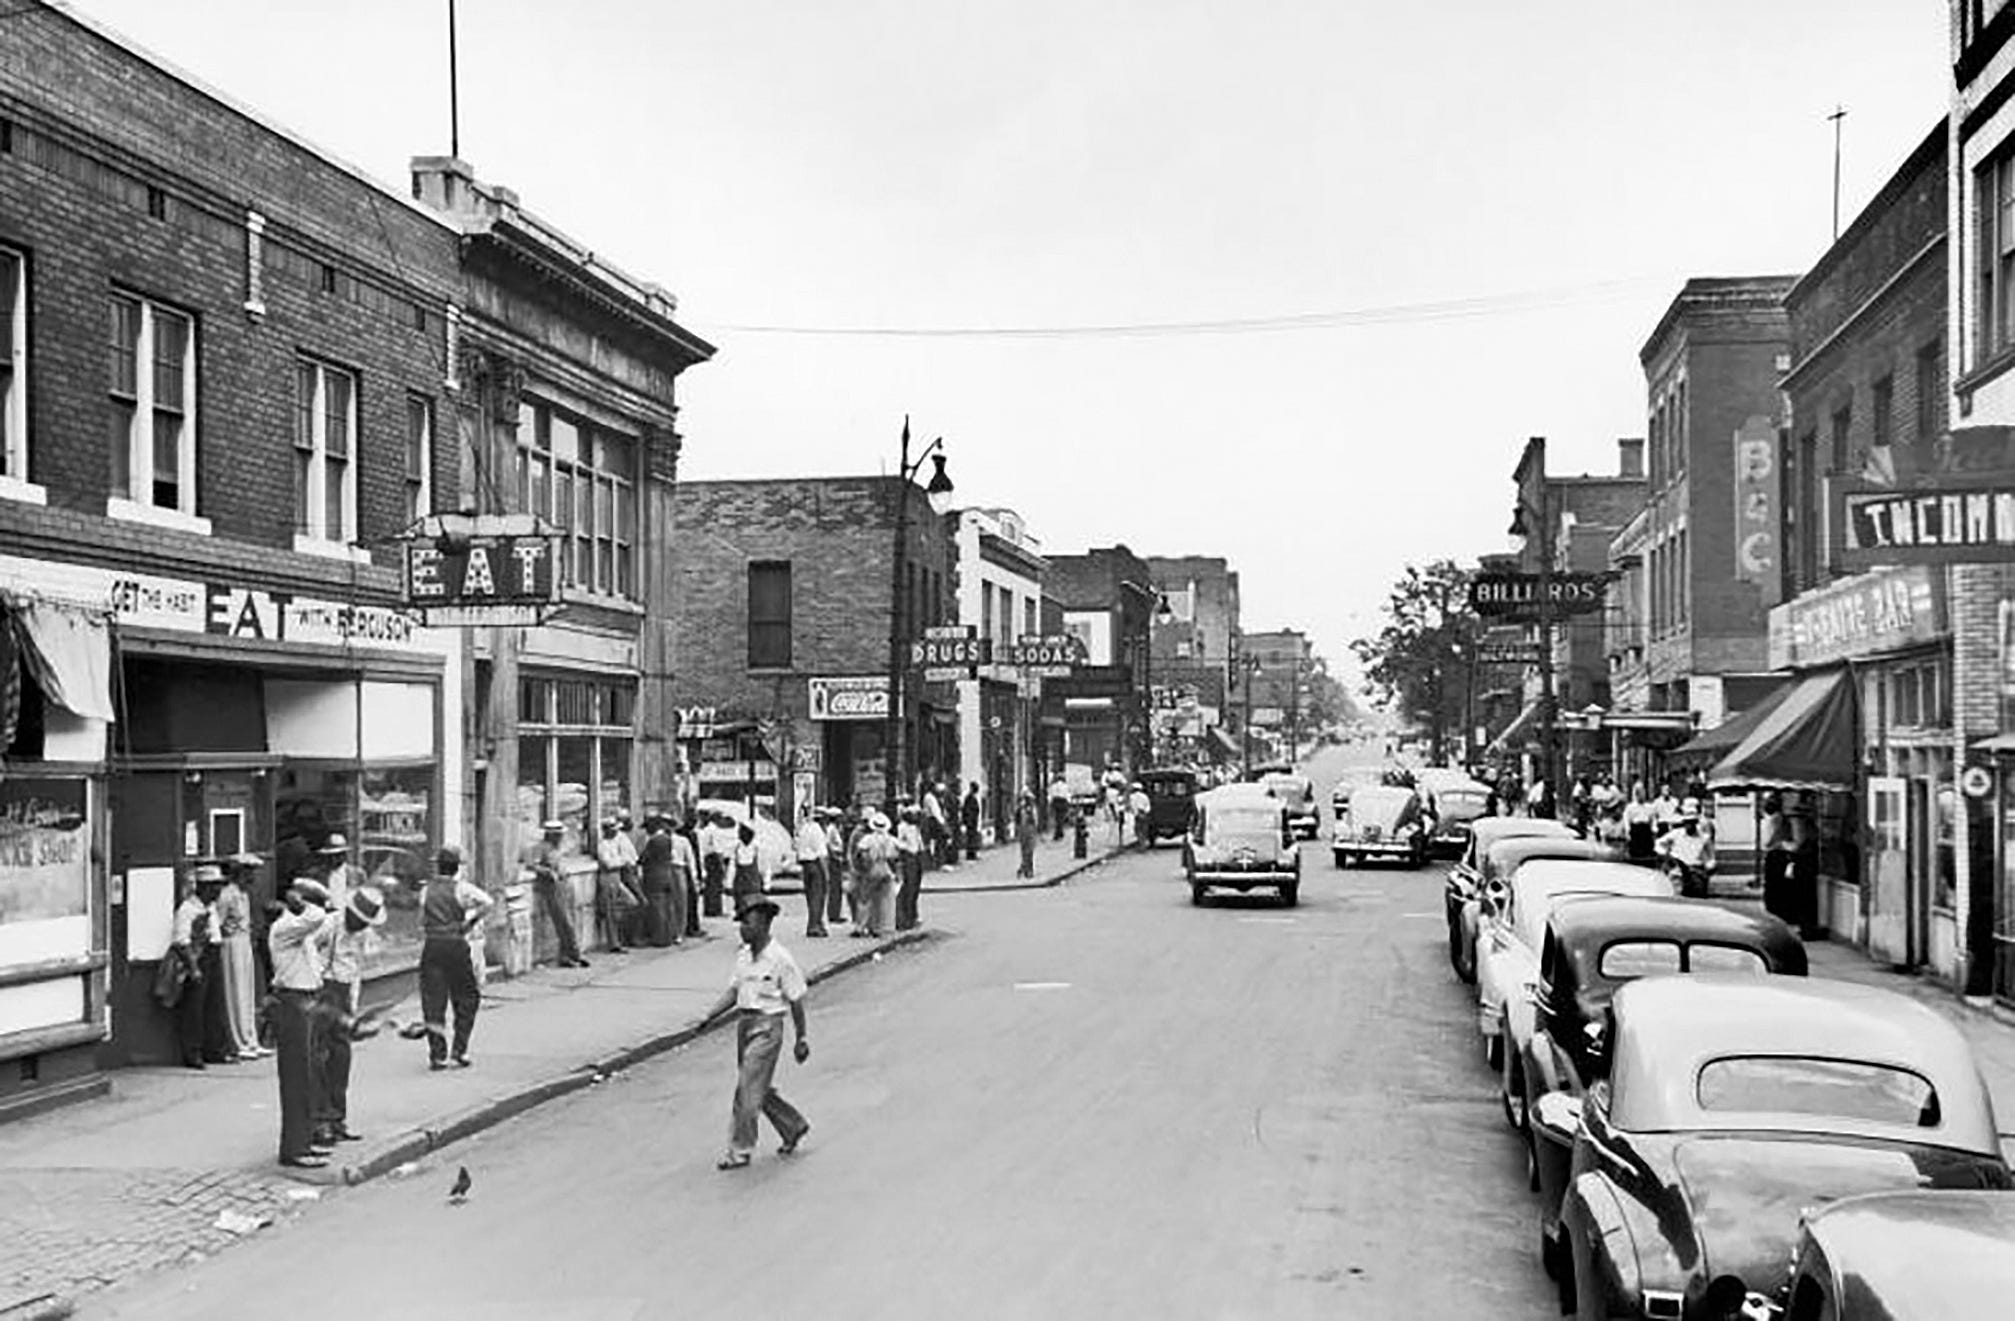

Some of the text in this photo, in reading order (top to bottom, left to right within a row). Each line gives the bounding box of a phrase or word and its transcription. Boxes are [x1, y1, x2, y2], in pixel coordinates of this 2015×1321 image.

[411, 547, 546, 595] EAT
[1477, 582, 1596, 602] BILLIRDS
[112, 580, 139, 612] GET
[205, 582, 294, 641] EAT
[337, 606, 412, 642] FERGUSON
[911, 641, 978, 663] DRUGS
[1014, 646, 1077, 664] SODAS
